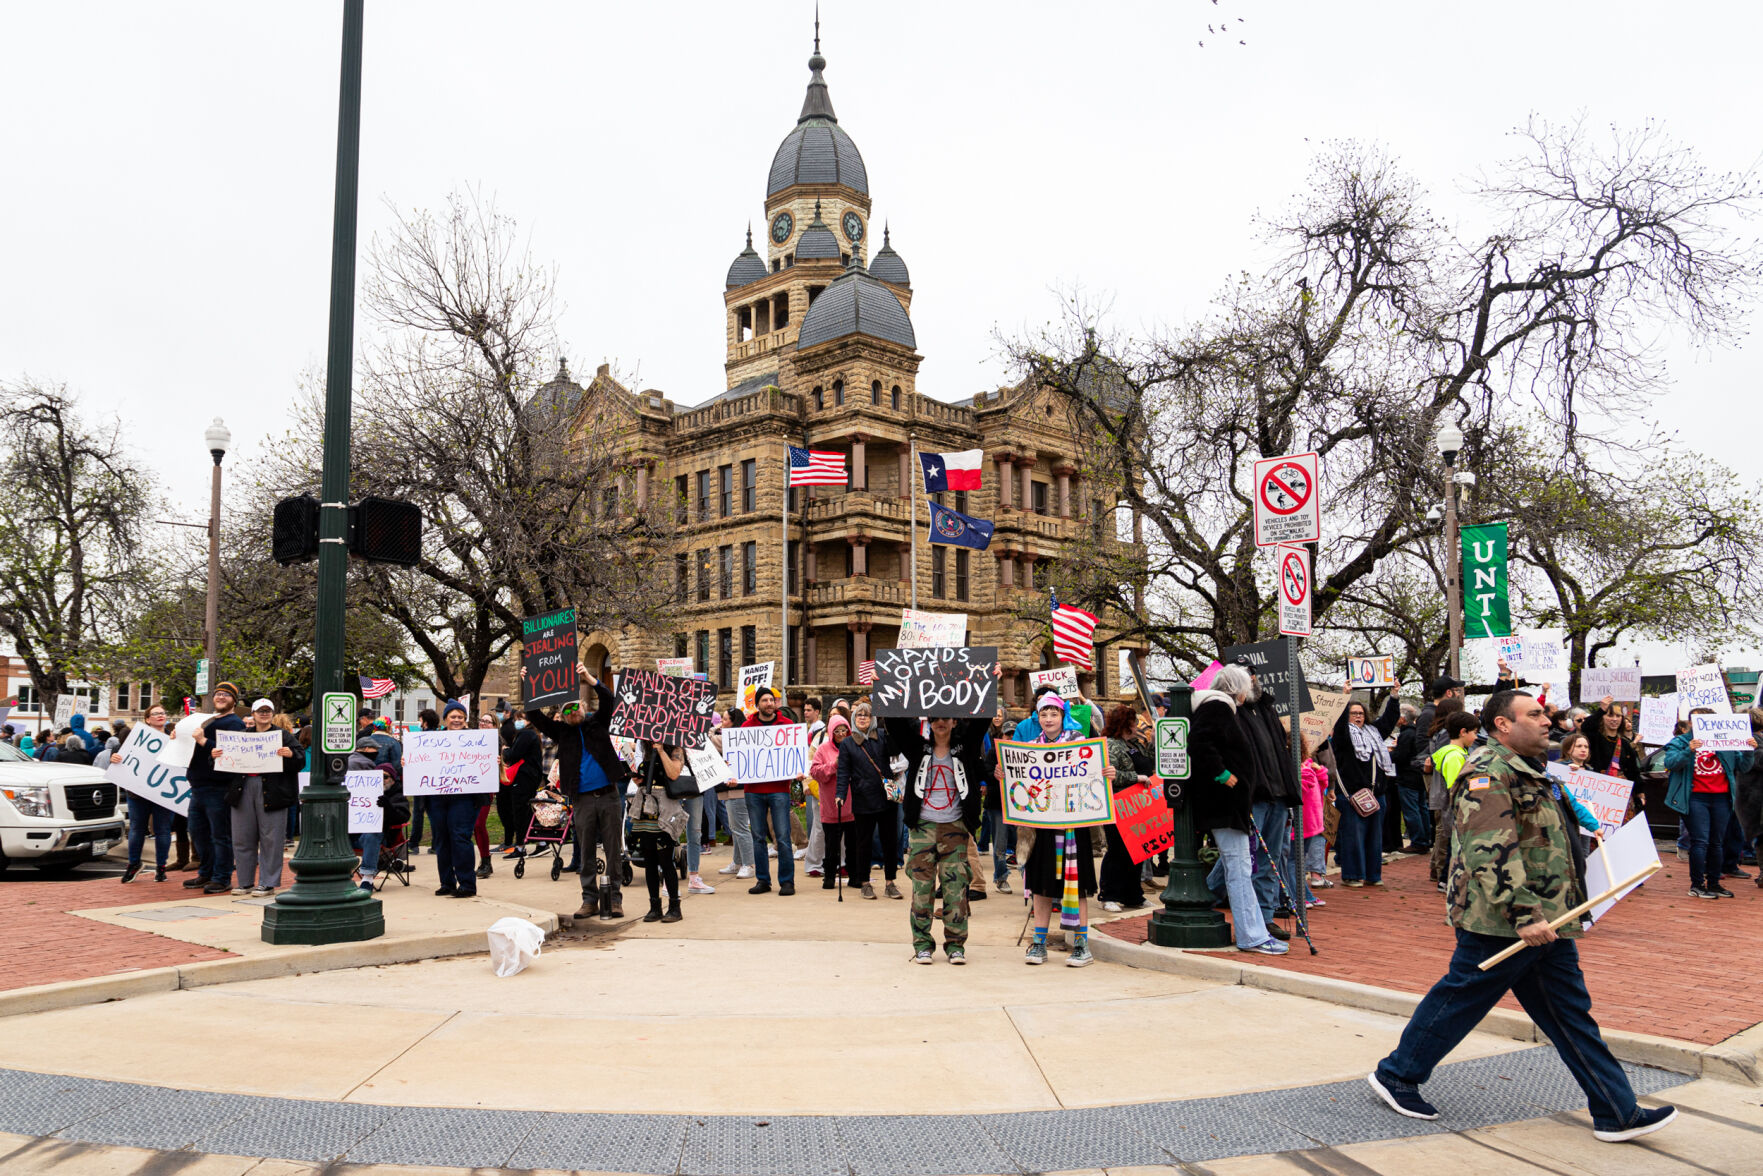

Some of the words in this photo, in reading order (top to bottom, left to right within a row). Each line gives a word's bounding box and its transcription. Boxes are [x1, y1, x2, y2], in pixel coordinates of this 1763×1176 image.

[1265, 516, 1287, 524] VEHICLES
[1284, 520, 1312, 528] PROHIBITED
[1472, 540, 1497, 616] UNT
[523, 608, 575, 634] BILLIONAIRES
[904, 610, 912, 618] I
[543, 629, 554, 639] ARE
[1500, 636, 1523, 646] RESIST
[525, 632, 574, 658] STEALING
[539, 654, 562, 667] FROM
[876, 648, 970, 672] HANDS
[744, 664, 768, 675] HANDS
[894, 660, 939, 680] OFF
[1038, 672, 1068, 684] FUCK
[1349, 658, 1394, 684] LOVE
[1700, 672, 1720, 681] 401K
[529, 661, 575, 698] YOU!
[624, 668, 676, 694] HANDS
[680, 679, 712, 700] OFF
[744, 673, 768, 686] OFF!
[642, 688, 700, 712] FIRST
[878, 679, 910, 709] MY
[919, 680, 992, 714] BODY
[1263, 687, 1275, 696] OR
[1698, 686, 1723, 698] COST
[1314, 694, 1335, 707] Stand
[1688, 694, 1724, 708] LIVING
[612, 701, 712, 733] AMENDMENT
[1697, 717, 1748, 731] DEMOCRACY
[134, 729, 162, 753] NO
[414, 734, 451, 748] Jesus
[459, 734, 488, 747] Said
[624, 719, 696, 748] RIGHTS
[728, 728, 773, 748] HANDS
[775, 726, 802, 746] OFF
[122, 750, 140, 776] in
[440, 752, 455, 764] Thy
[726, 746, 806, 780] EDUCATION
[1005, 749, 1037, 764] HANDS
[1044, 750, 1073, 764] OFF
[440, 764, 466, 774] NOT
[1007, 766, 1026, 778] THE
[1029, 761, 1088, 780] QUEENS
[420, 776, 480, 788] ALIENATE
[1568, 772, 1632, 799] INJUSTICE
[1010, 778, 1104, 813] QUEERS
[1574, 788, 1596, 800] LAW
[1115, 789, 1152, 820] HANDS
[1130, 810, 1174, 838] VOTING
